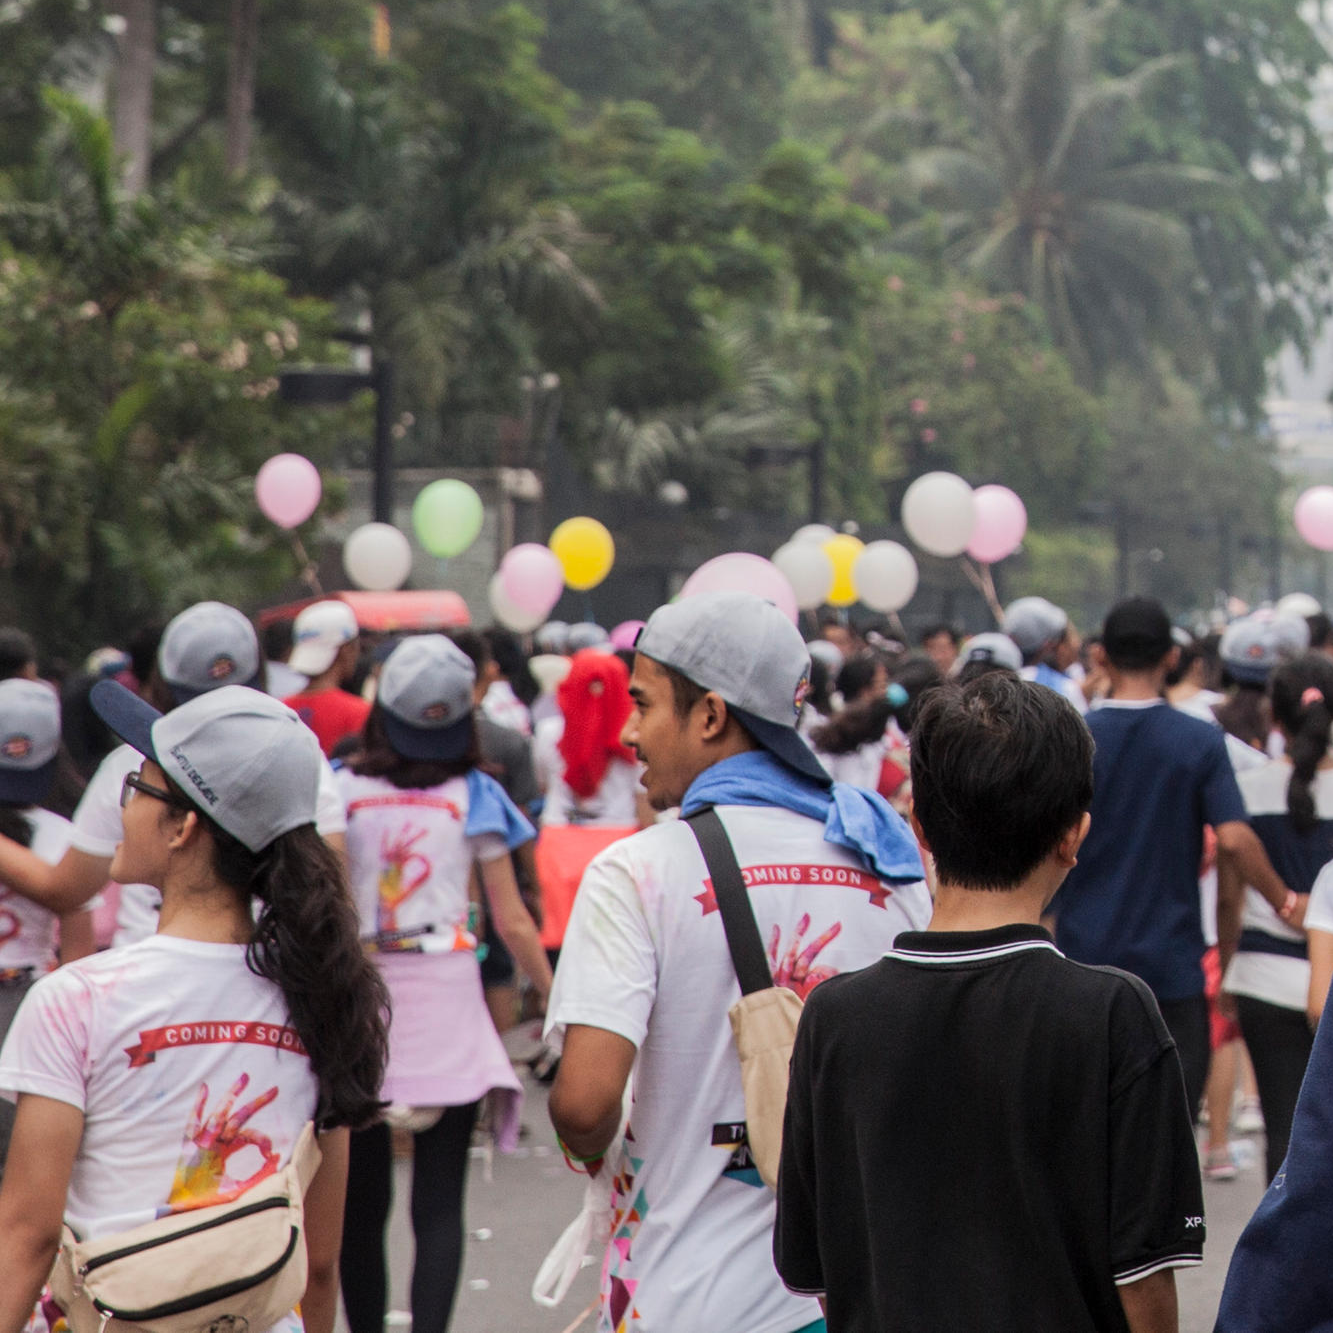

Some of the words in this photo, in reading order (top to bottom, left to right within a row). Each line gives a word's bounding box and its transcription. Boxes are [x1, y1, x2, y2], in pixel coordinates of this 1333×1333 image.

[741, 866, 801, 884] OMING
[808, 867, 862, 885] SOON
[165, 1024, 247, 1044] COMING
